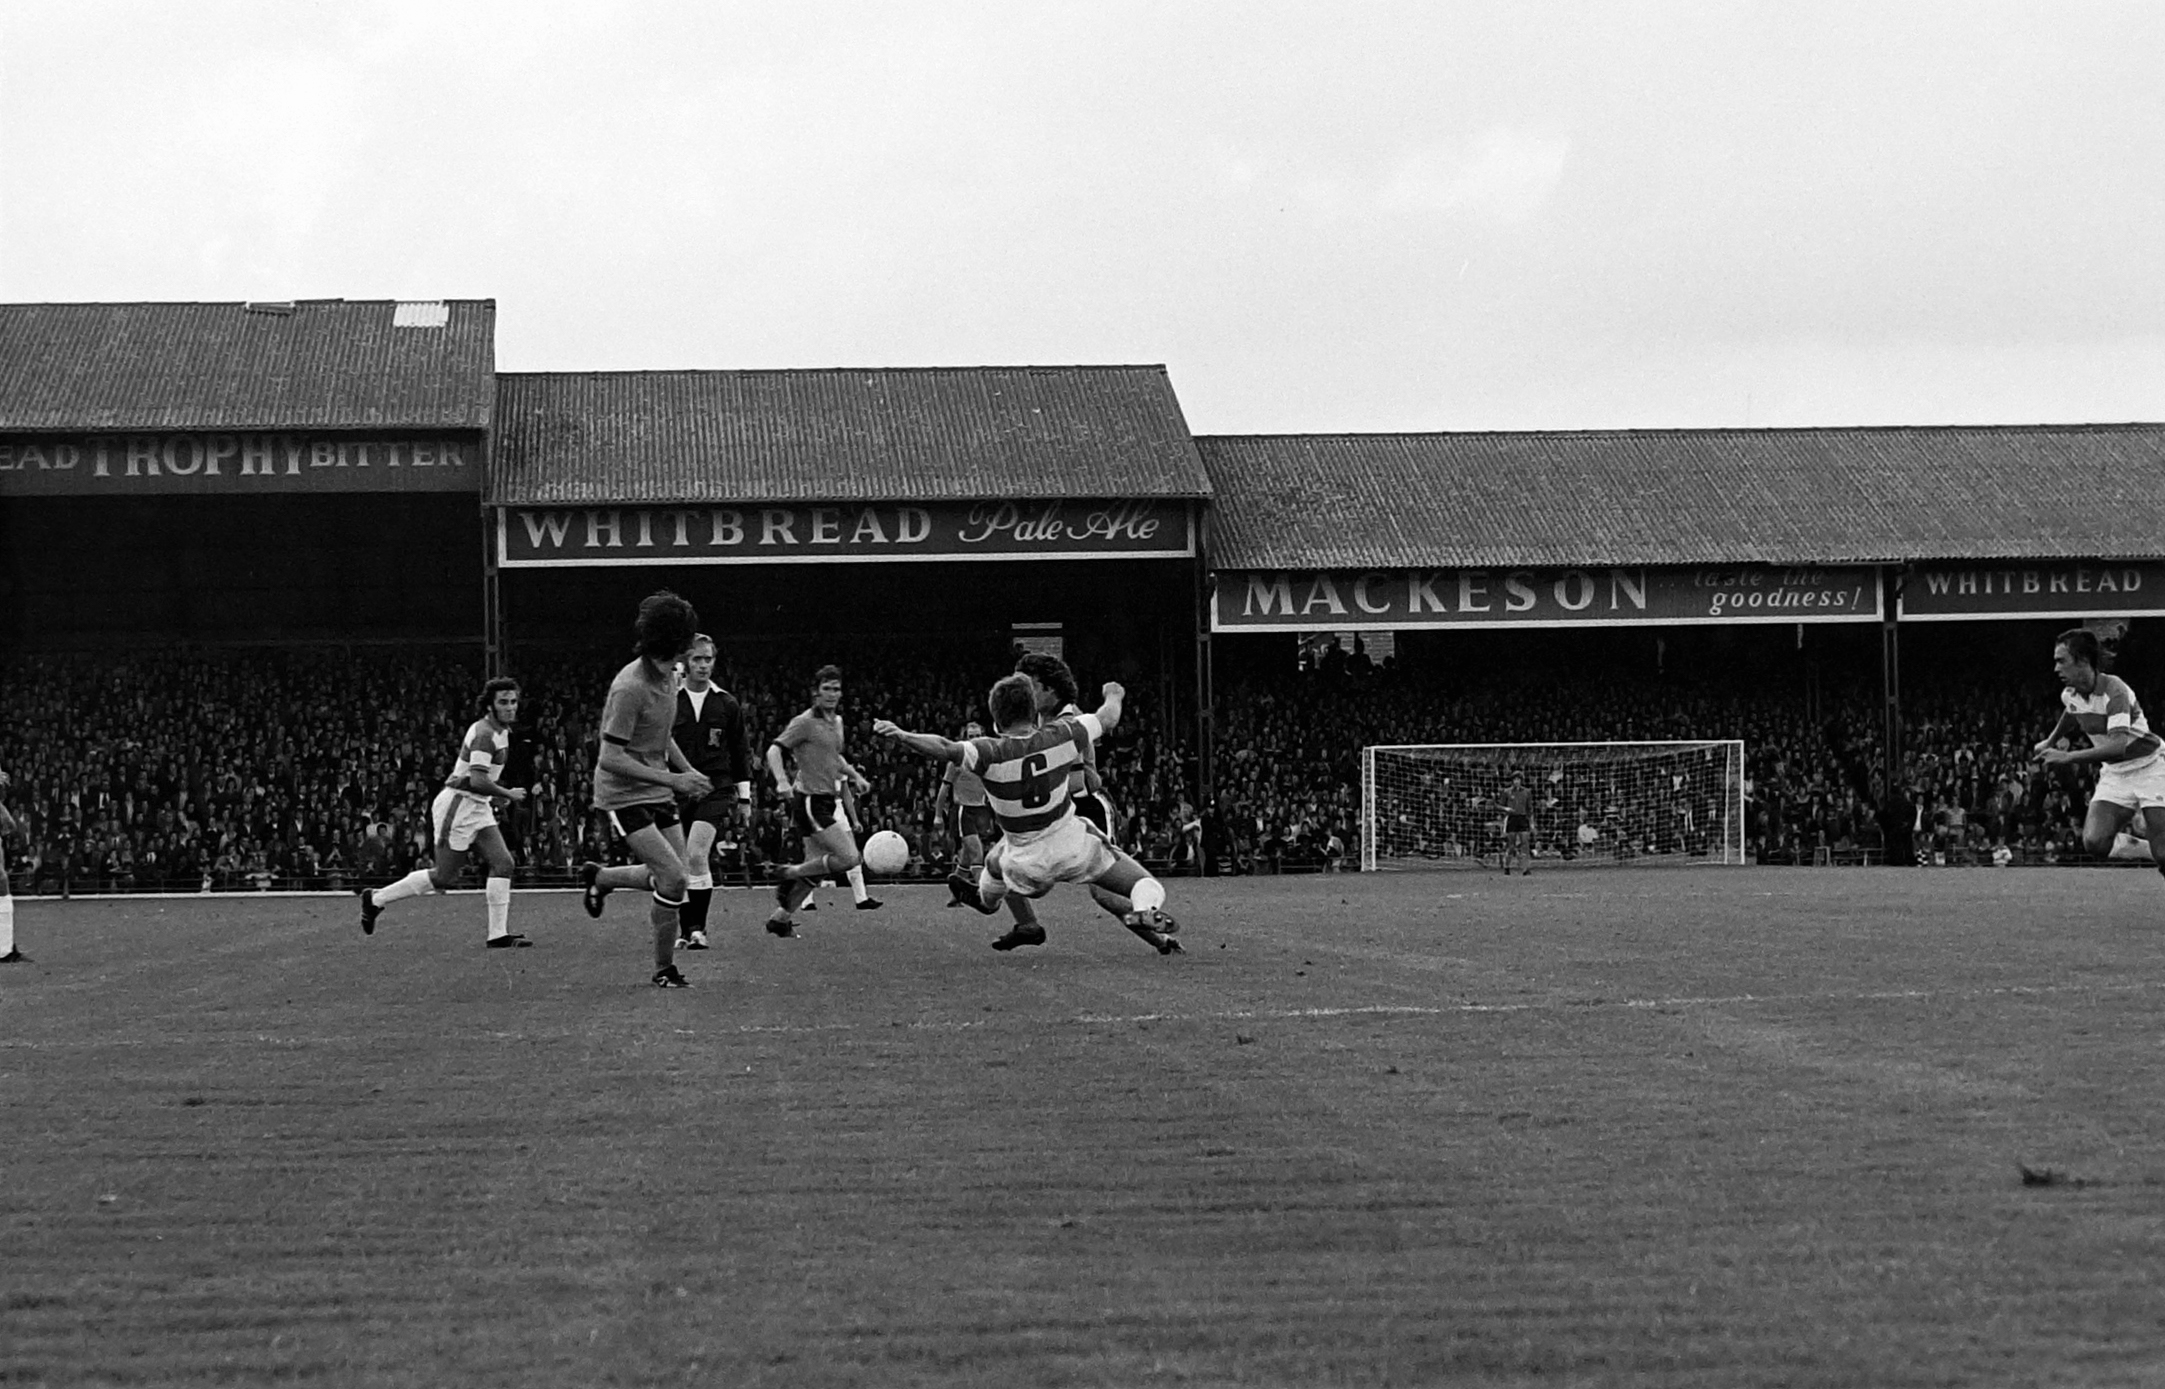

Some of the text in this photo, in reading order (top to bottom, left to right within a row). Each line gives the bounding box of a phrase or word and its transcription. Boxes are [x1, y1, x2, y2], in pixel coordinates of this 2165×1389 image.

[86, 434, 302, 477] TROPHY
[310, 442, 466, 467] BITTER
[518, 500, 1160, 548] WHITBREAD Pale Ale
[1242, 569, 1648, 616] MACKESON
[1709, 586, 1861, 616] goodness!
[1925, 568, 2142, 595] WHITBREAD
[1021, 753, 1051, 809] 6
